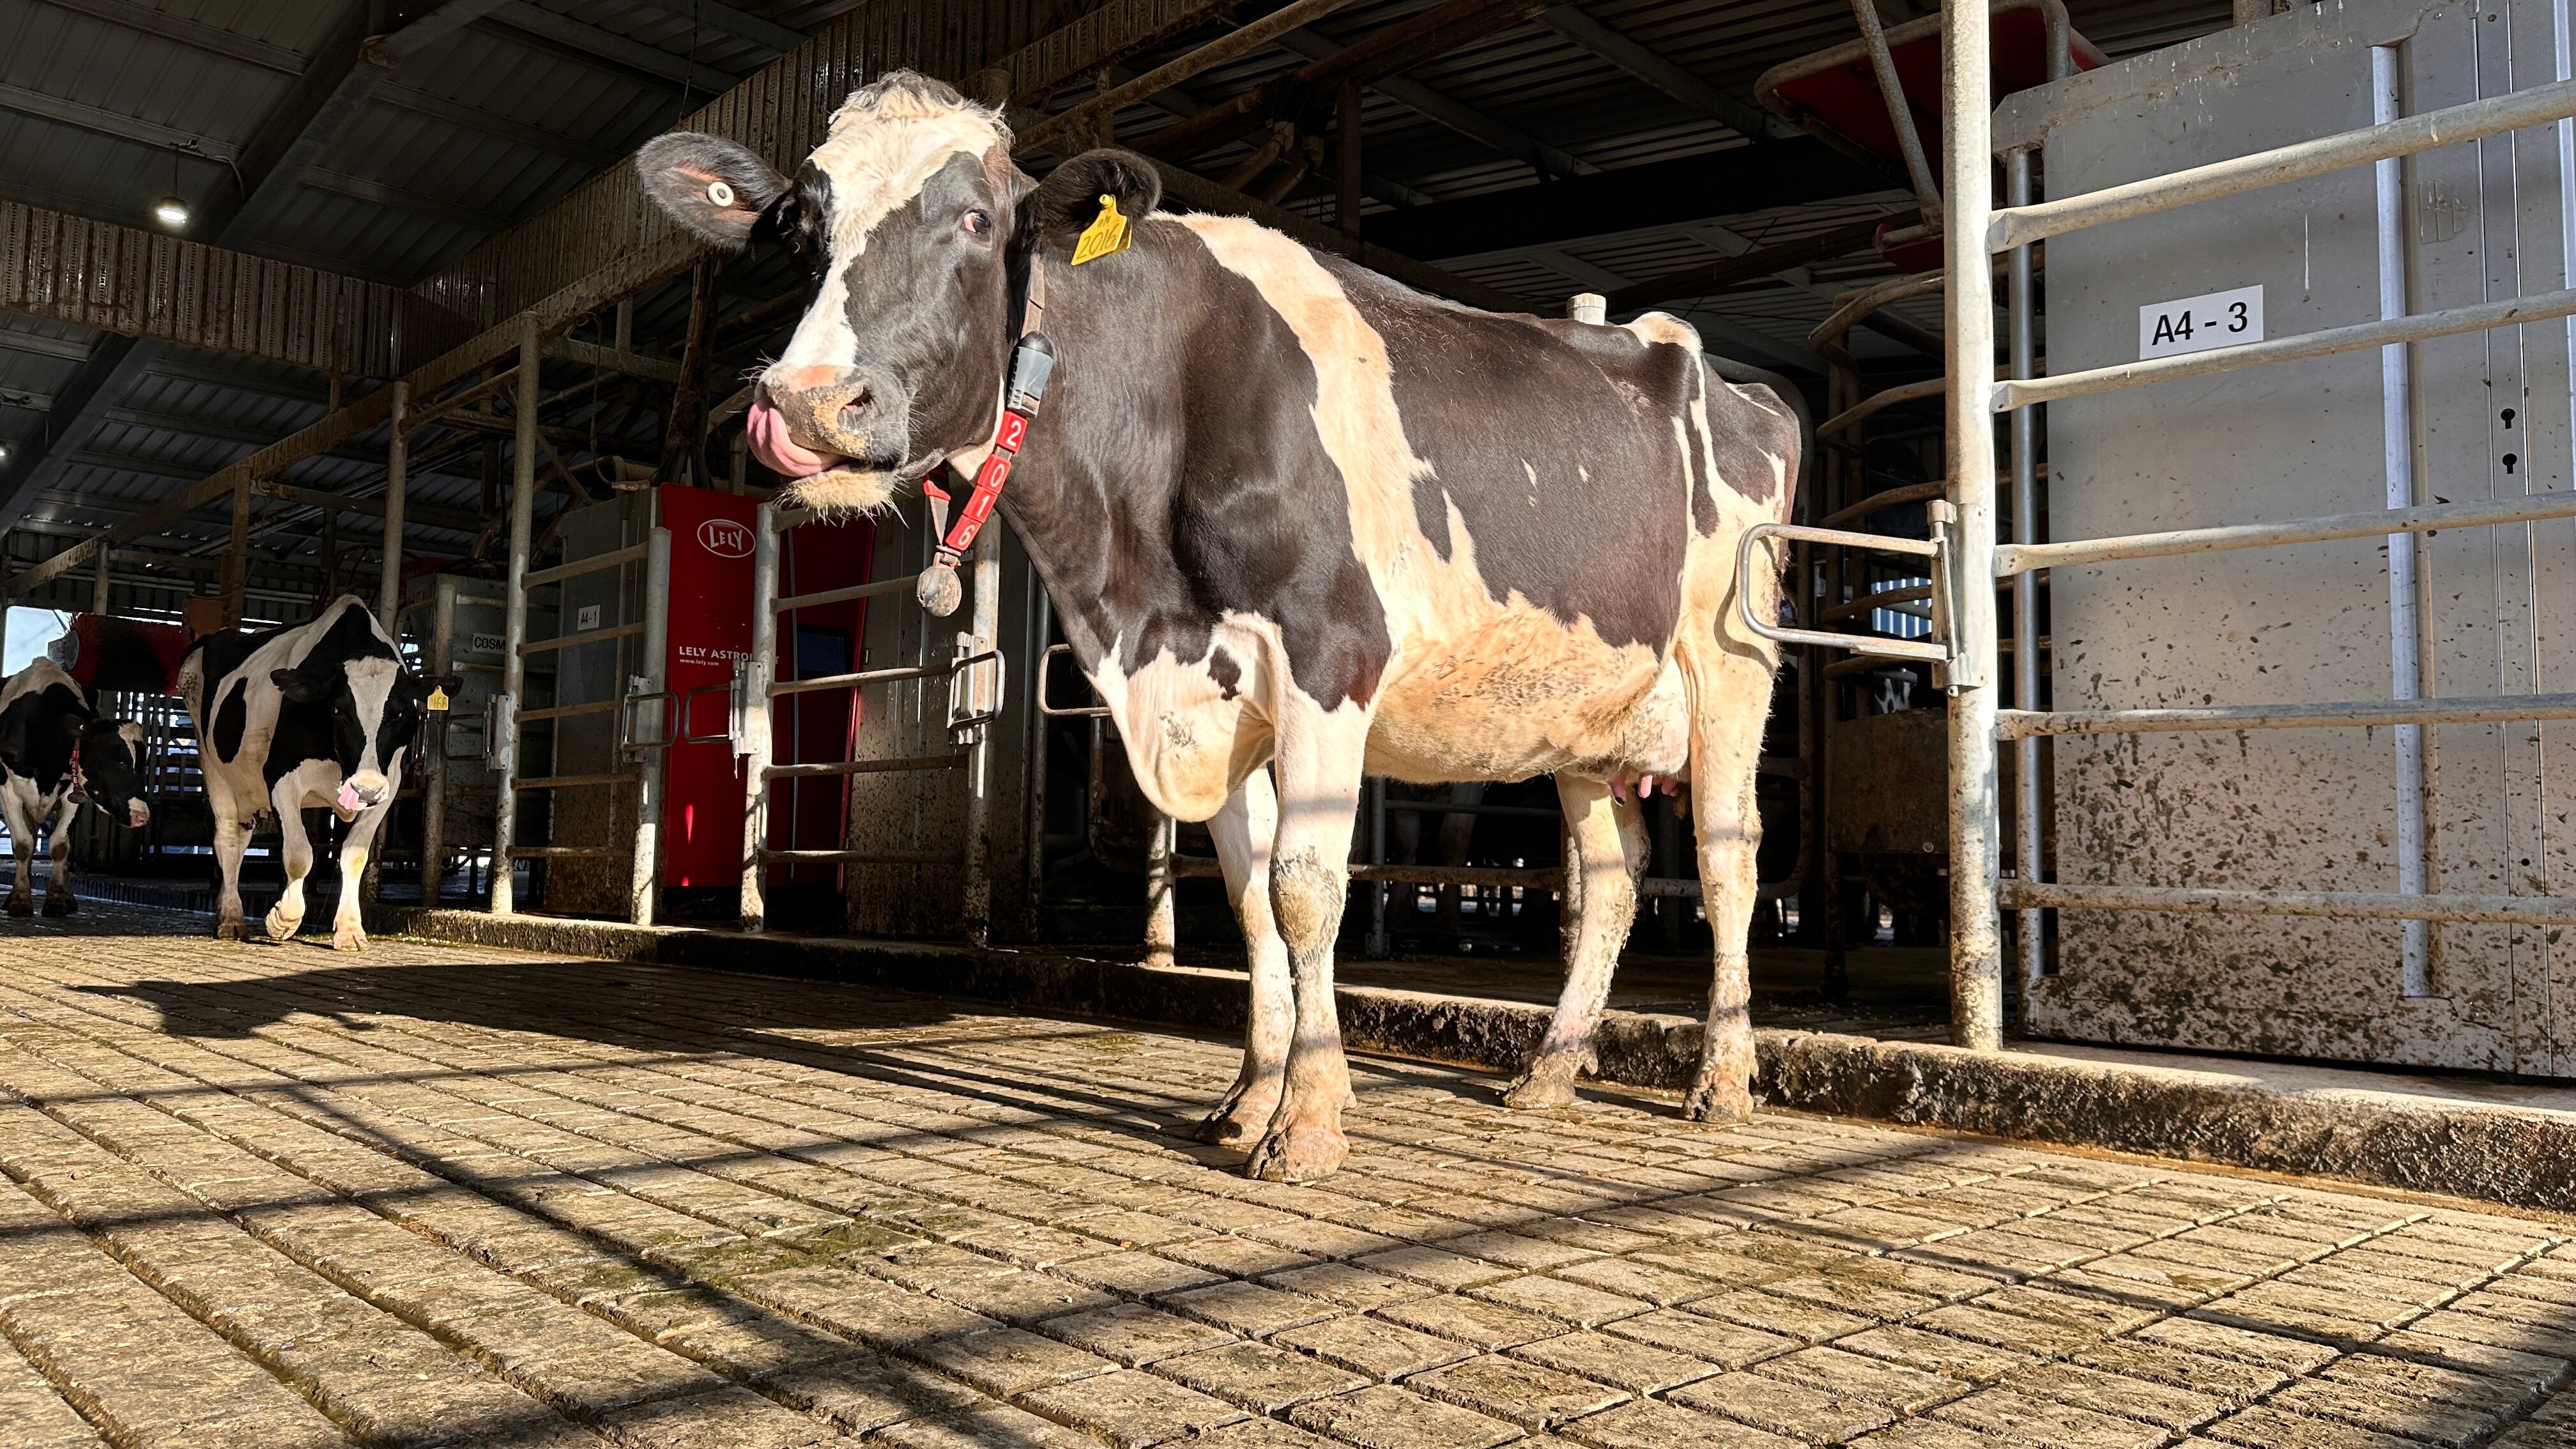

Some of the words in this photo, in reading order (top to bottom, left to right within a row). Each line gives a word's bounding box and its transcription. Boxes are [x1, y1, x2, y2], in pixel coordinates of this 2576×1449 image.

[1076, 223, 1120, 259] 2016
[2152, 310, 2194, 346] A4
[2228, 302, 2248, 333] 3
[709, 525, 743, 551] LELY
[474, 637, 506, 650] COSM
[679, 646, 707, 657] LELY
[710, 649, 779, 664] ASTROT
